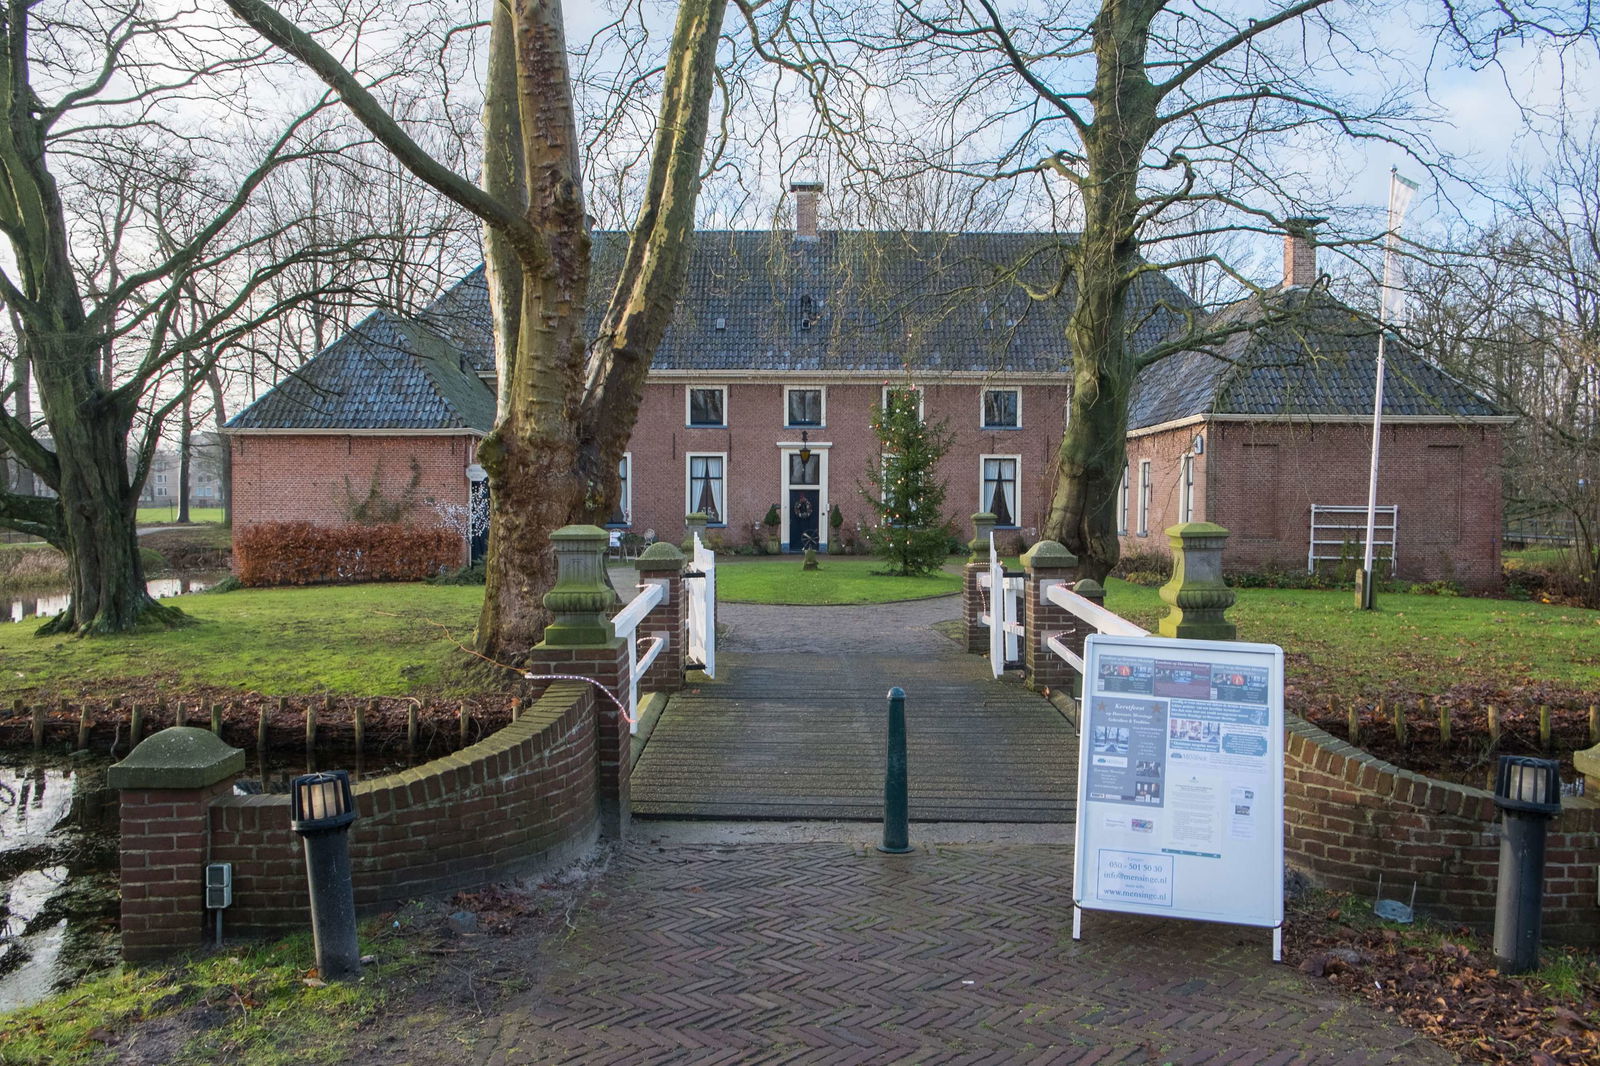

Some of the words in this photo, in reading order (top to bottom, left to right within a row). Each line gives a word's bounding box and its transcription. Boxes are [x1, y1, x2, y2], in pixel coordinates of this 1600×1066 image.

[1109, 861, 1123, 869] 050
[1129, 863, 1141, 871] 501
[1103, 872, 1168, 884] info@mensinge.nl
[1103, 888, 1168, 900] www.mensinge.nl
